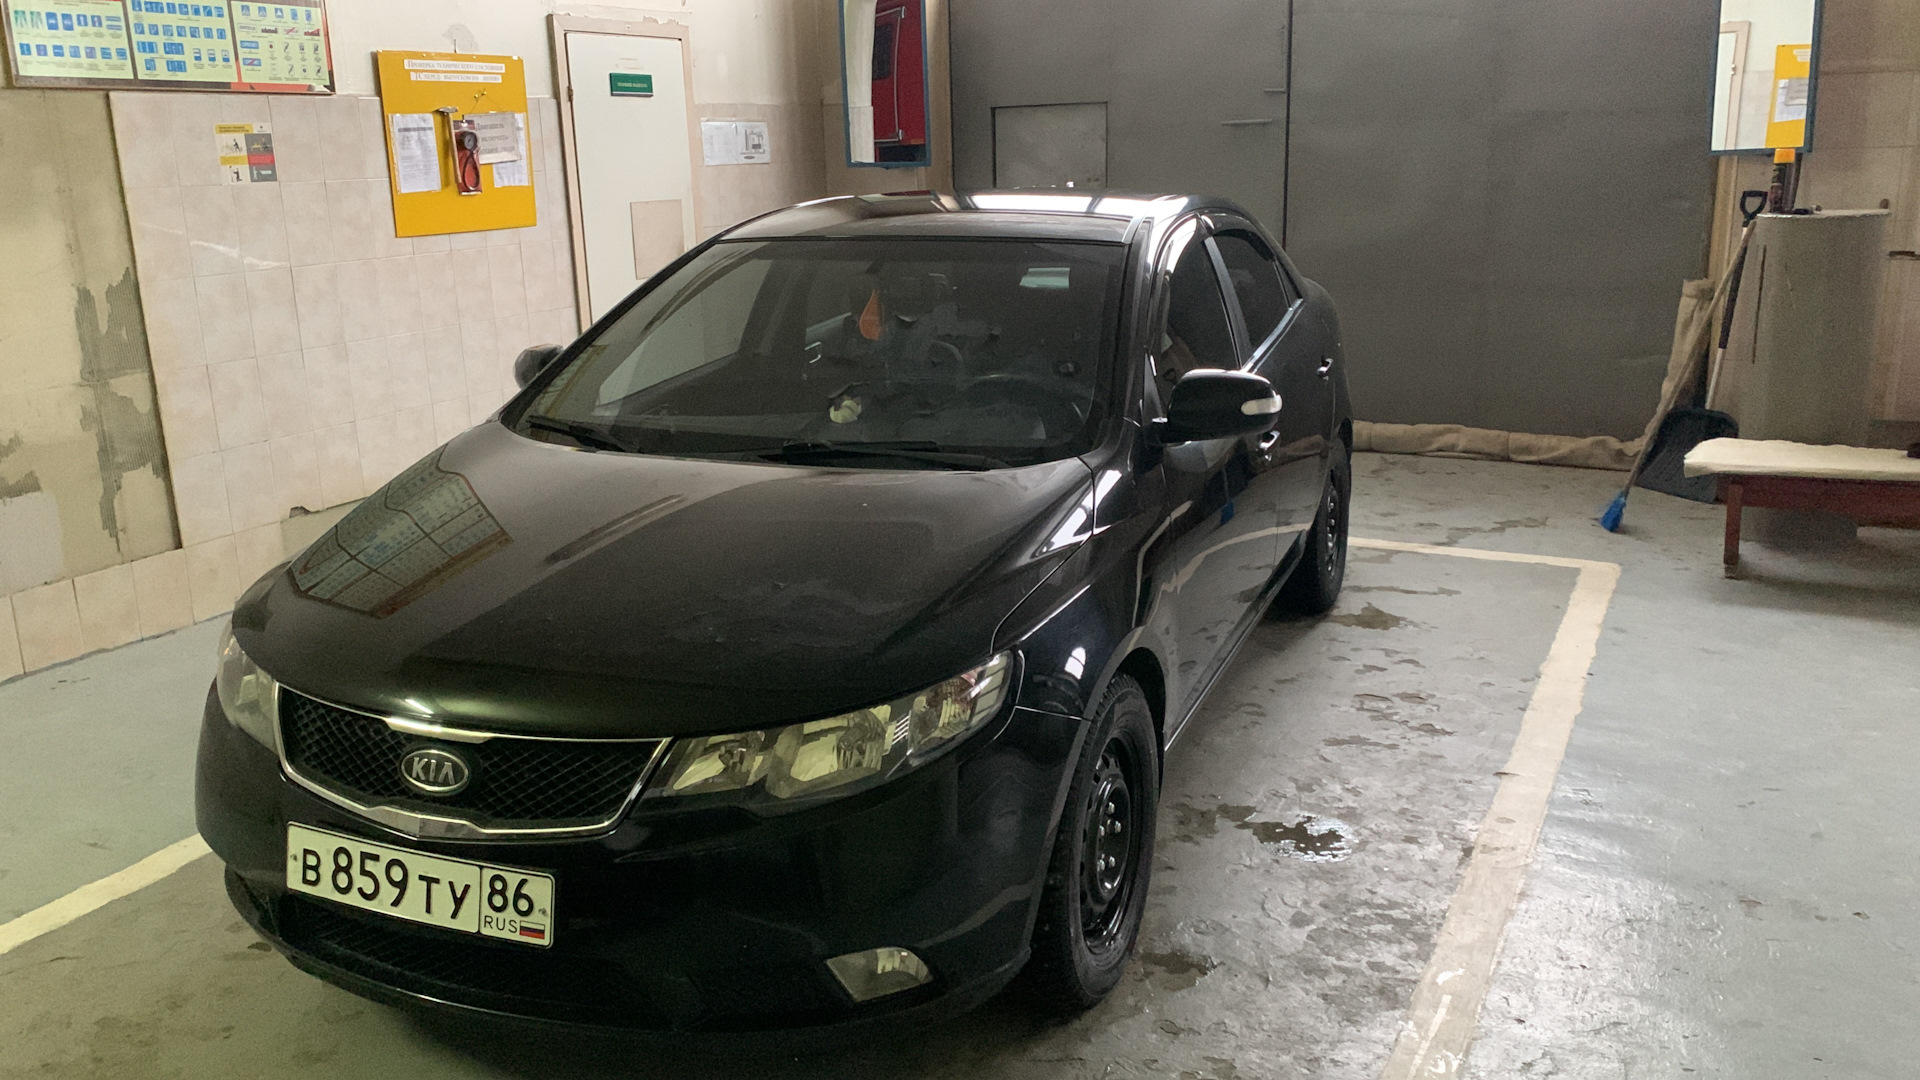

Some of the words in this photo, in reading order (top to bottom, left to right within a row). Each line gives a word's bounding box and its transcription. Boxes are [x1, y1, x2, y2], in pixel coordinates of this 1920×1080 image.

[412, 756, 456, 784] KIA
[487, 874, 534, 917] 86
[483, 915, 518, 934] RUS
